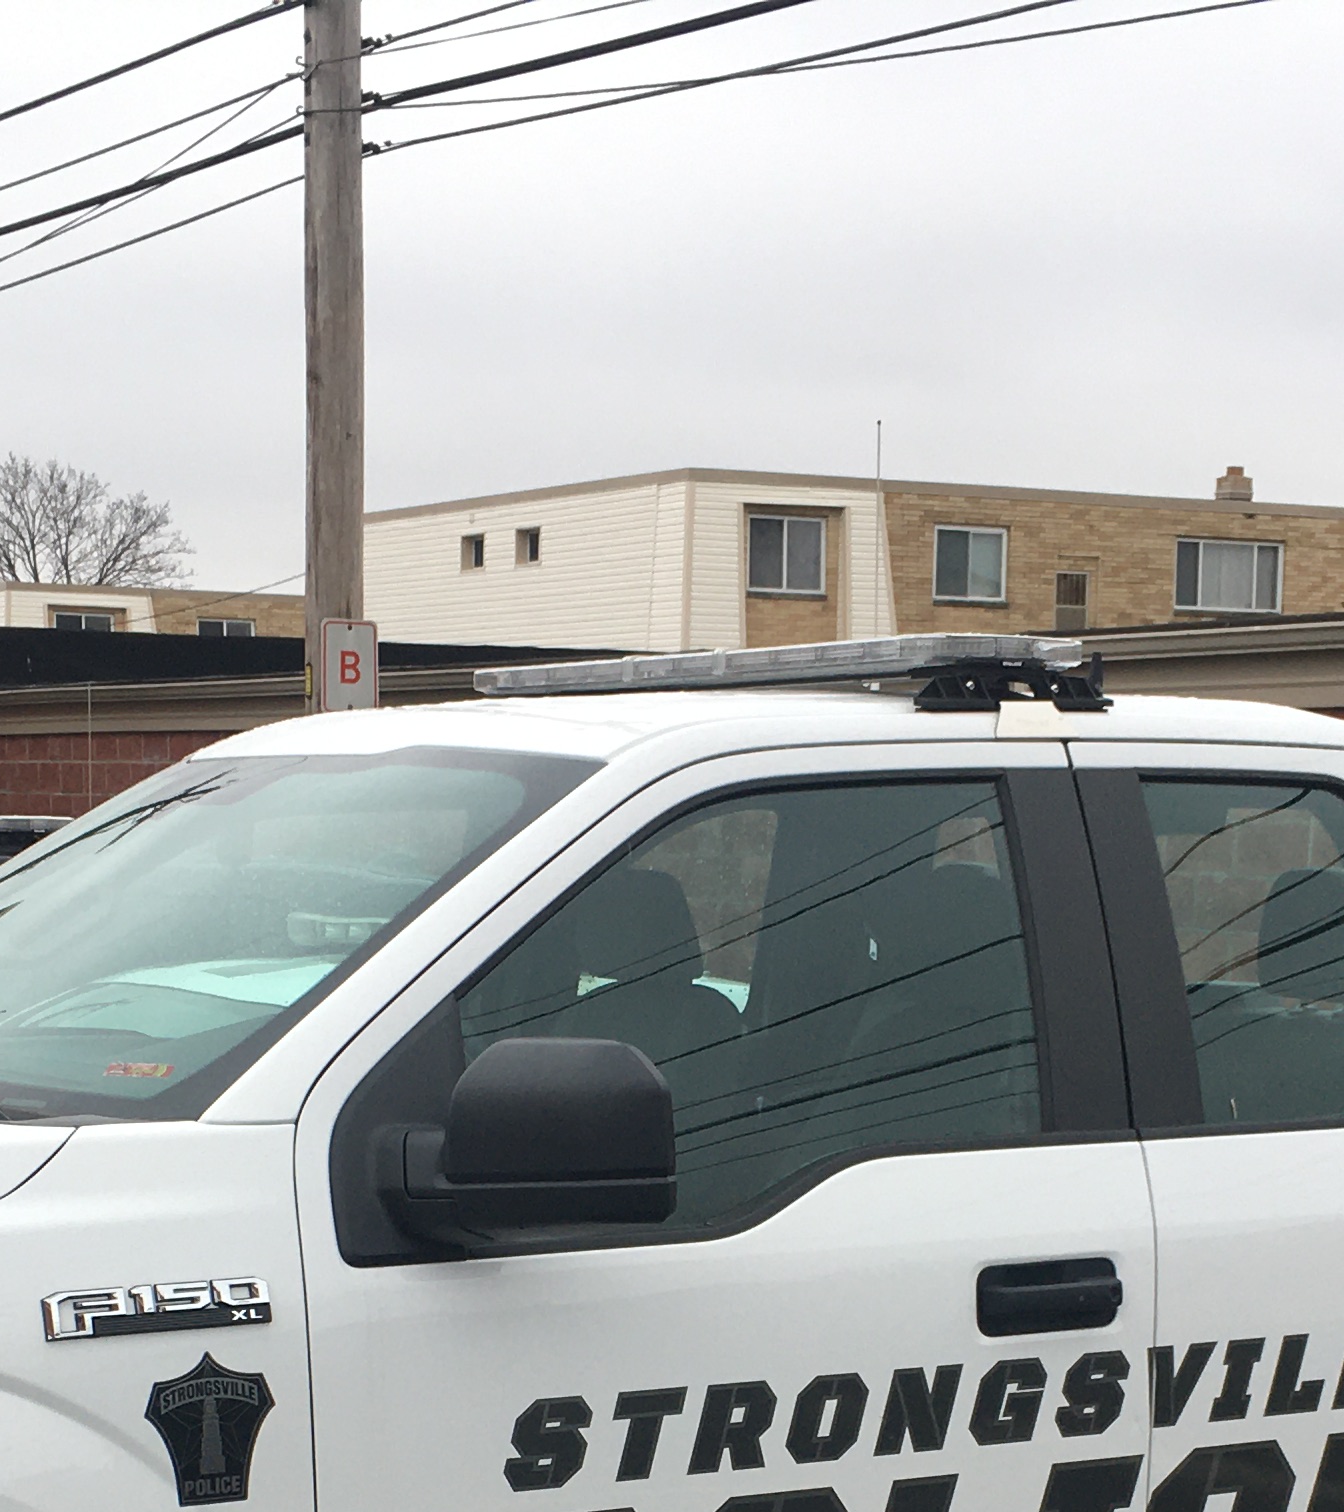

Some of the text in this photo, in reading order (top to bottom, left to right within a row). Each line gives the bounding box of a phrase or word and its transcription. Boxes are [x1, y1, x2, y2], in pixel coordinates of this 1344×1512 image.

[339, 650, 361, 685] B
[41, 1276, 271, 1341] F150
[231, 1308, 264, 1321] XL
[162, 1379, 256, 1409] STRONGSVILLE
[184, 1474, 242, 1498] POLICE
